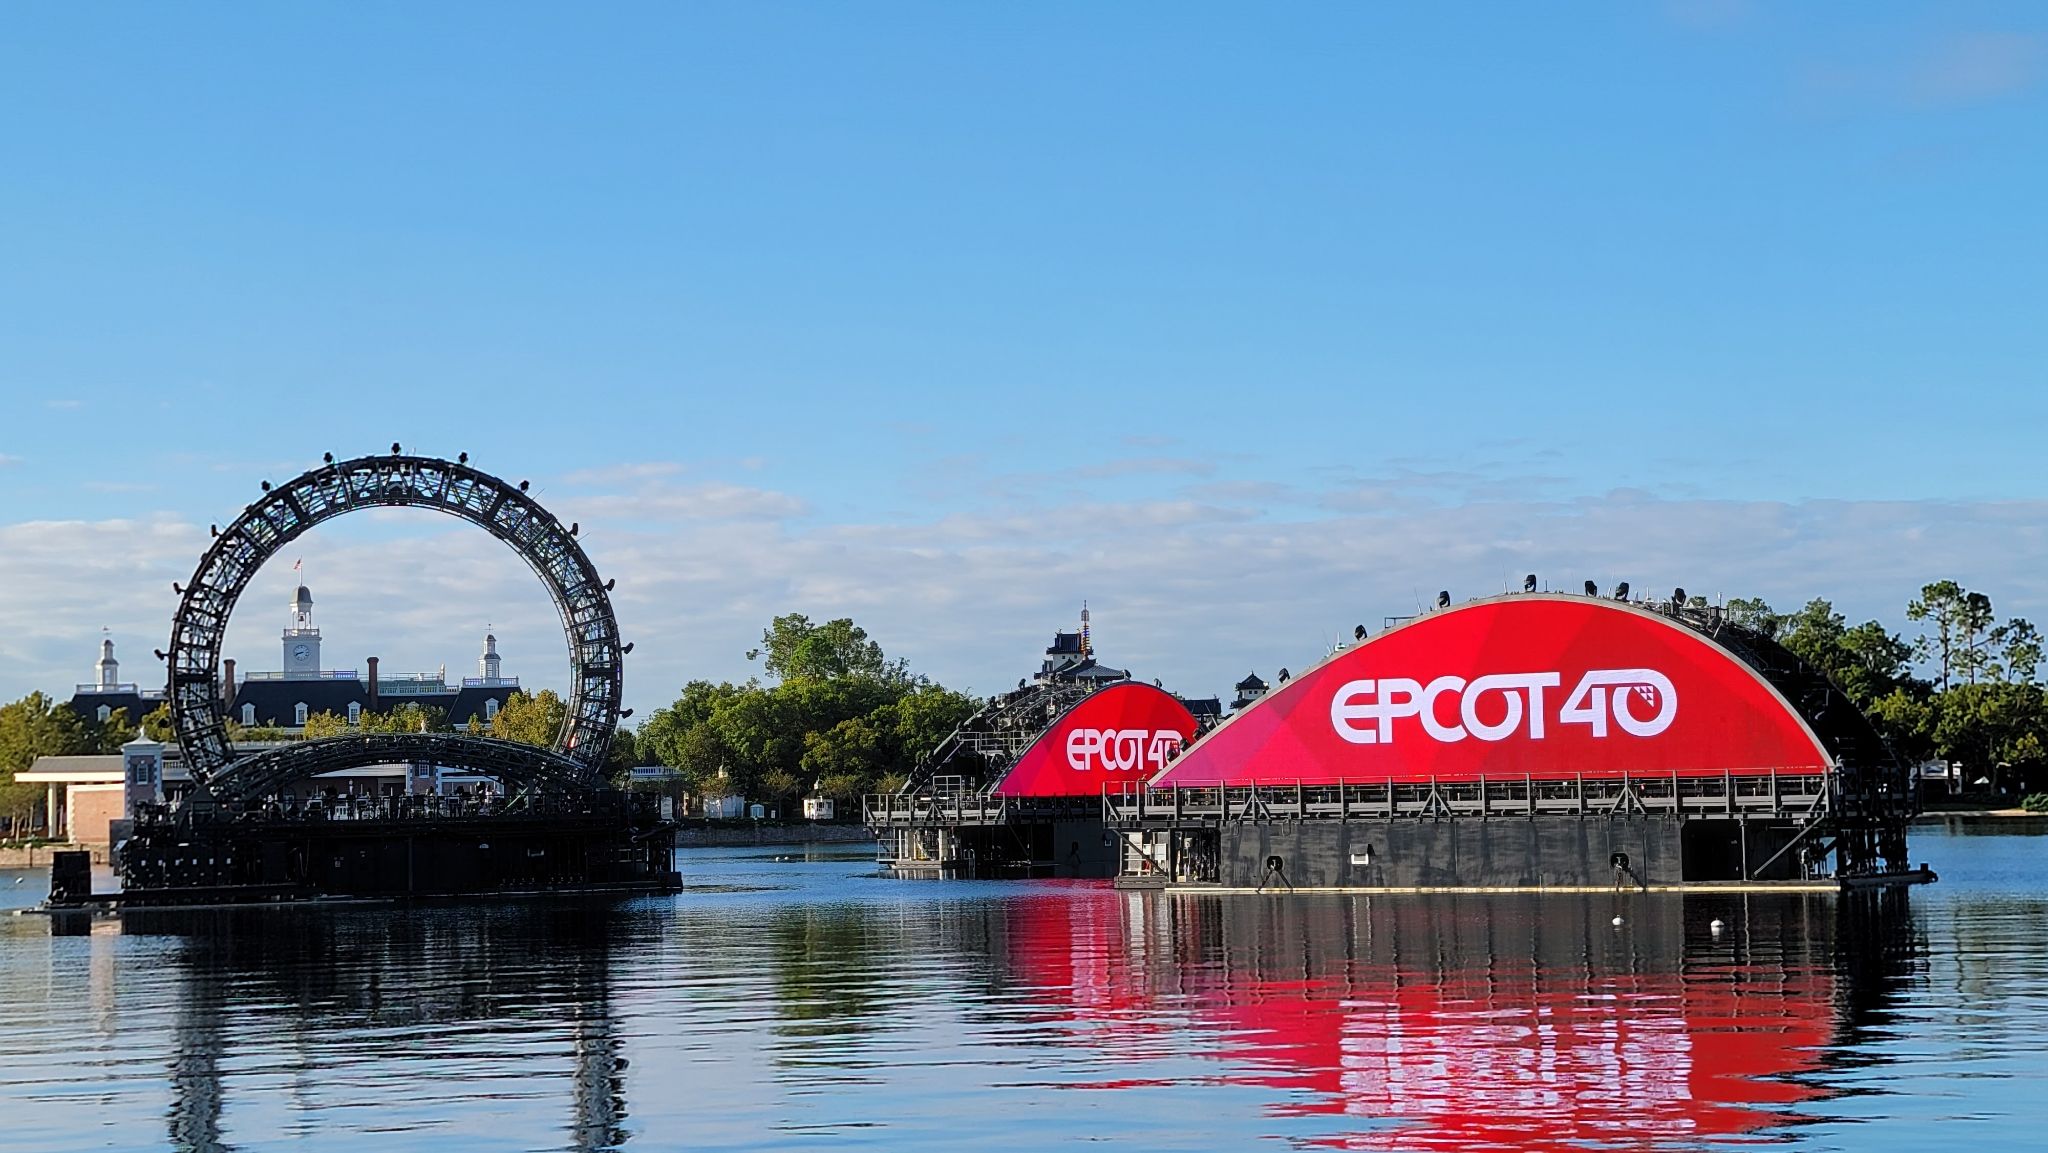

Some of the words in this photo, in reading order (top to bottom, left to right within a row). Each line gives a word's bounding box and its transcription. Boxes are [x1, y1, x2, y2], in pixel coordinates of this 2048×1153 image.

[1331, 672, 1560, 743] EPCOT
[1560, 668, 1678, 737] 40
[1067, 728, 1149, 770] EPCOT
